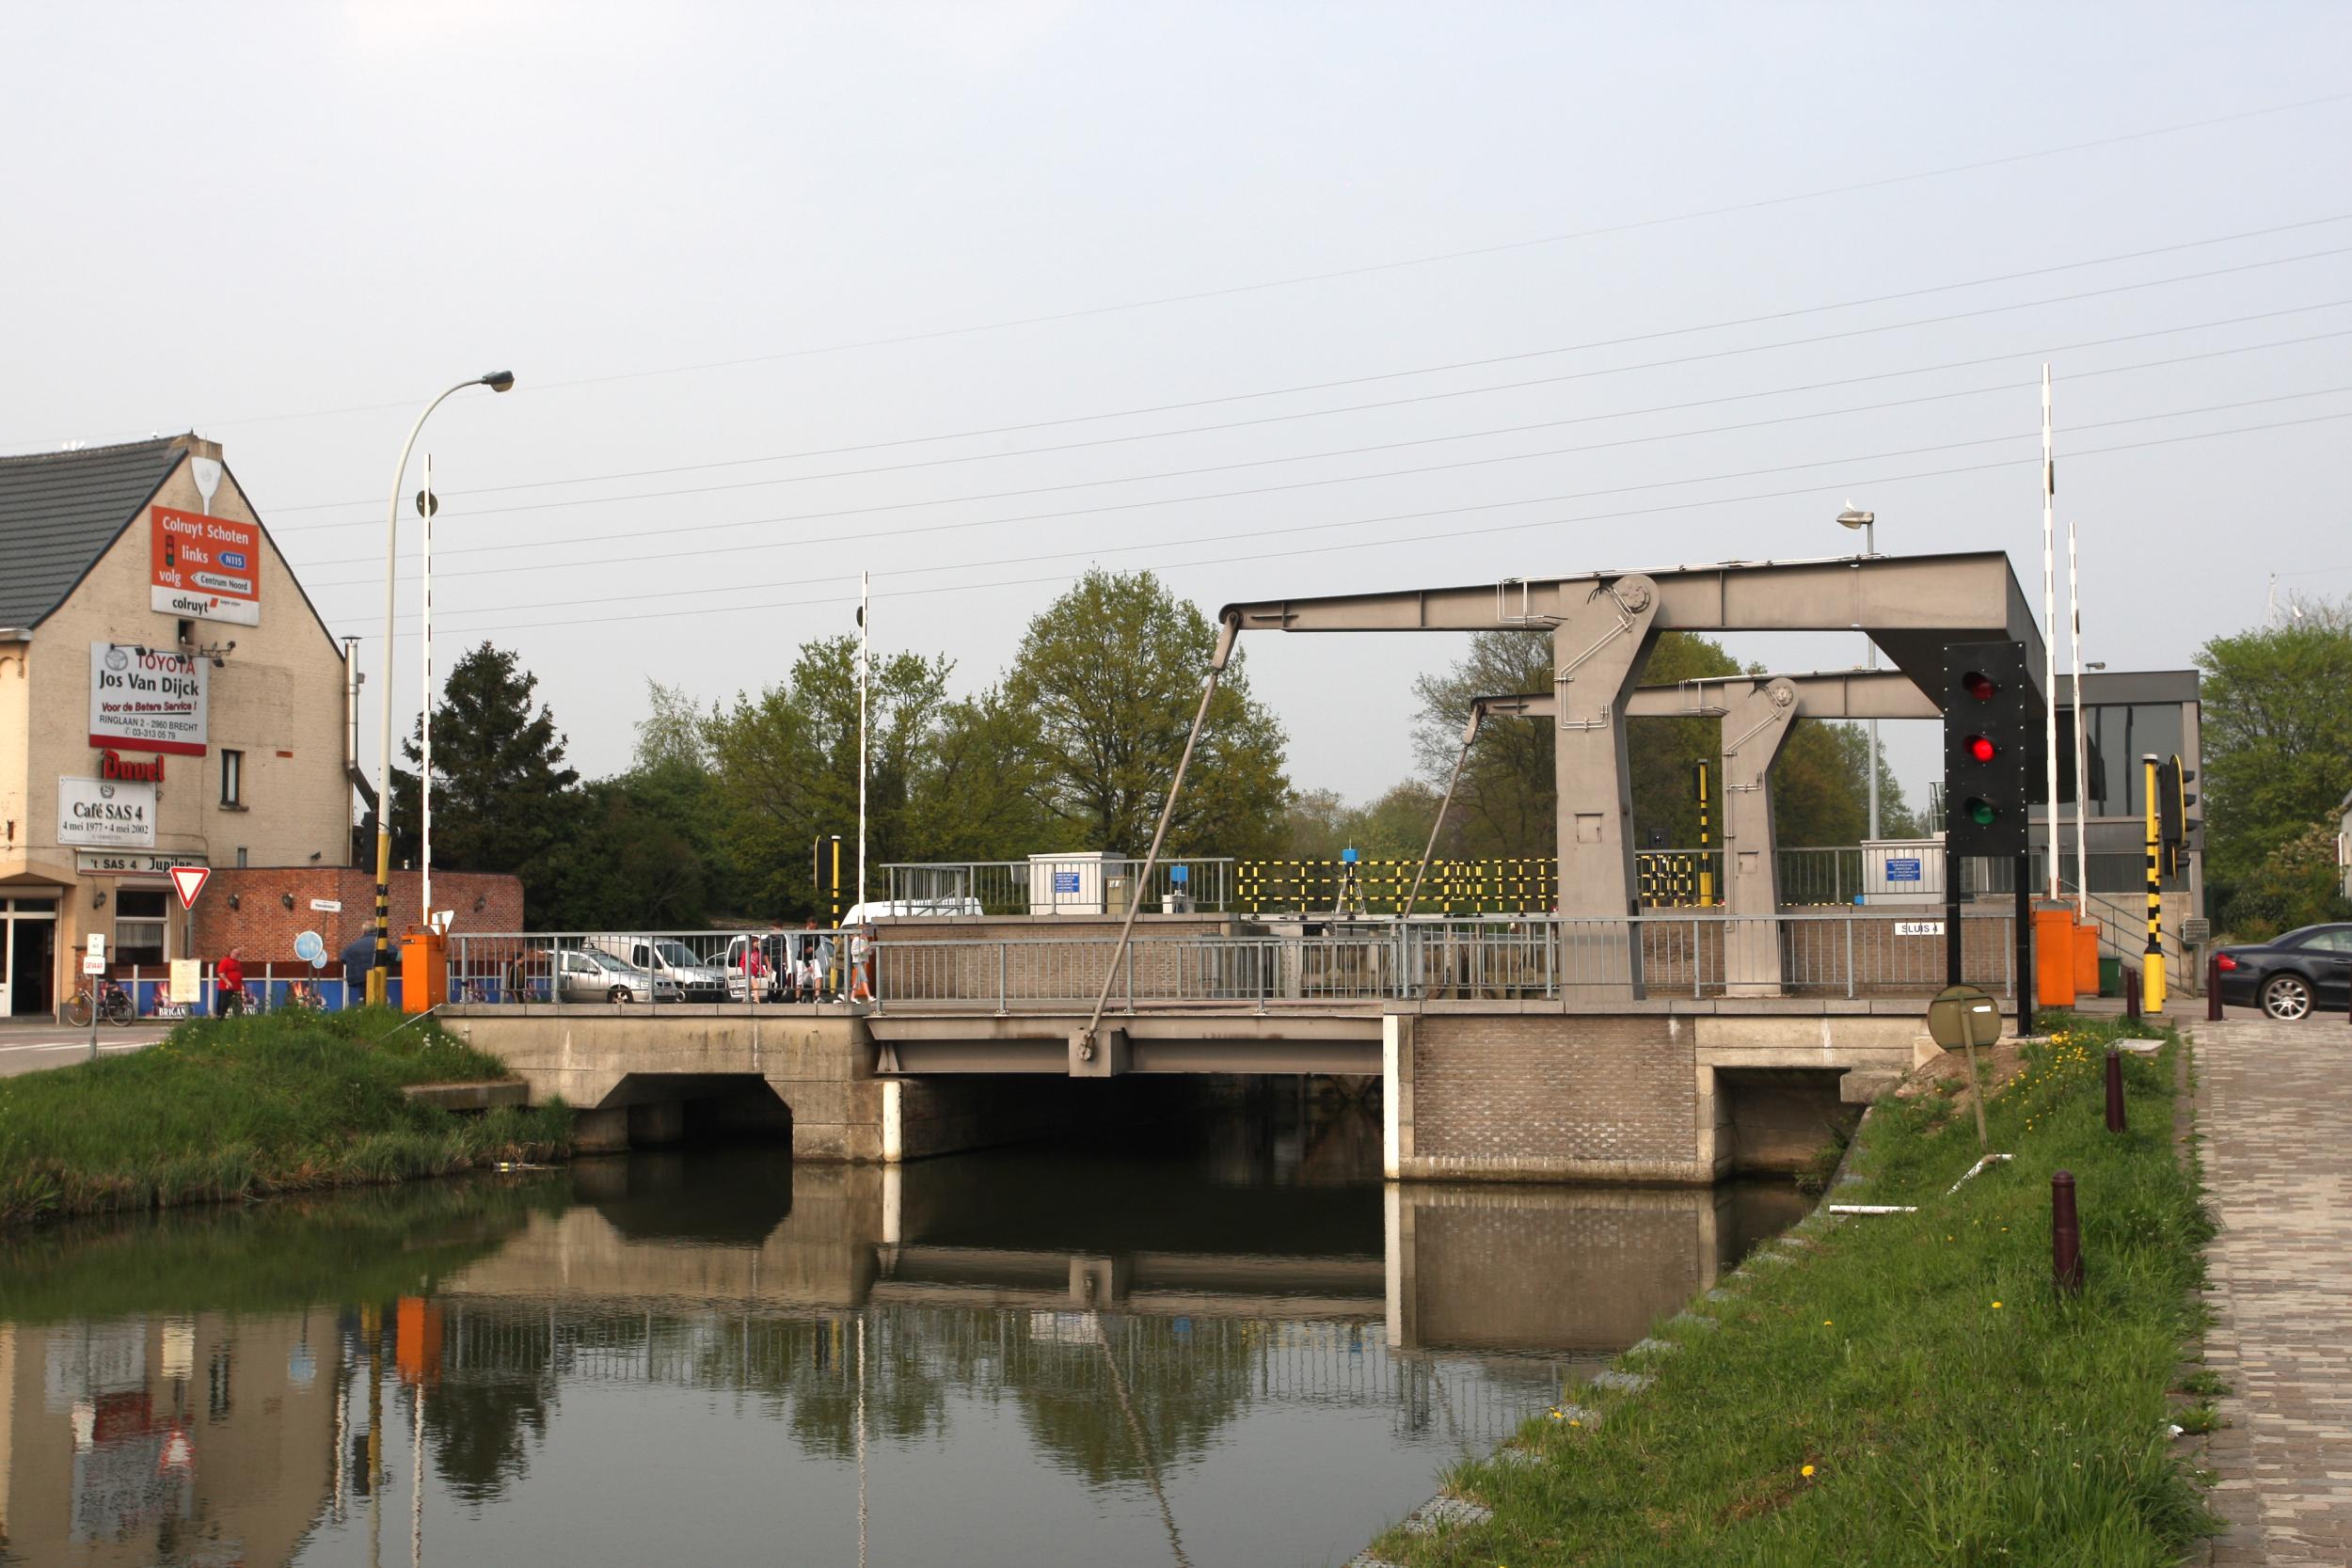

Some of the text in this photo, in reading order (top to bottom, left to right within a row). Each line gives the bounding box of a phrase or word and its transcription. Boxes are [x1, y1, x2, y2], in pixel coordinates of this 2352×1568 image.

[163, 516, 249, 545] Colruyt Schoten
[182, 545, 208, 563] links
[226, 556, 242, 565] N115
[159, 569, 181, 587] volg
[201, 575, 247, 590] Centrum Noord
[172, 597, 208, 615] colruyt
[136, 653, 195, 675] TOYOTA
[99, 670, 199, 699] Jos Van Dijck
[102, 703, 121, 712] Voor
[123, 702, 133, 711] de
[135, 702, 162, 711] Betere
[164, 701, 192, 711] Service
[99, 715, 138, 726] RINGLAAN
[151, 720, 167, 729] 2960
[169, 722, 198, 731] BRECHT
[133, 729, 156, 738] 03-313
[102, 749, 165, 782] Duvel
[74, 802, 143, 821] Café SAS 4
[69, 822, 83, 831] mei
[86, 822, 103, 832] 1977
[110, 824, 114, 832] 4
[116, 824, 129, 833] mei
[132, 825, 148, 834] 2002
[103, 859, 125, 870] SAS
[130, 860, 137, 870] 4
[1901, 925, 1930, 933] SLUIS
[159, 1007, 187, 1016] BRIGAN
